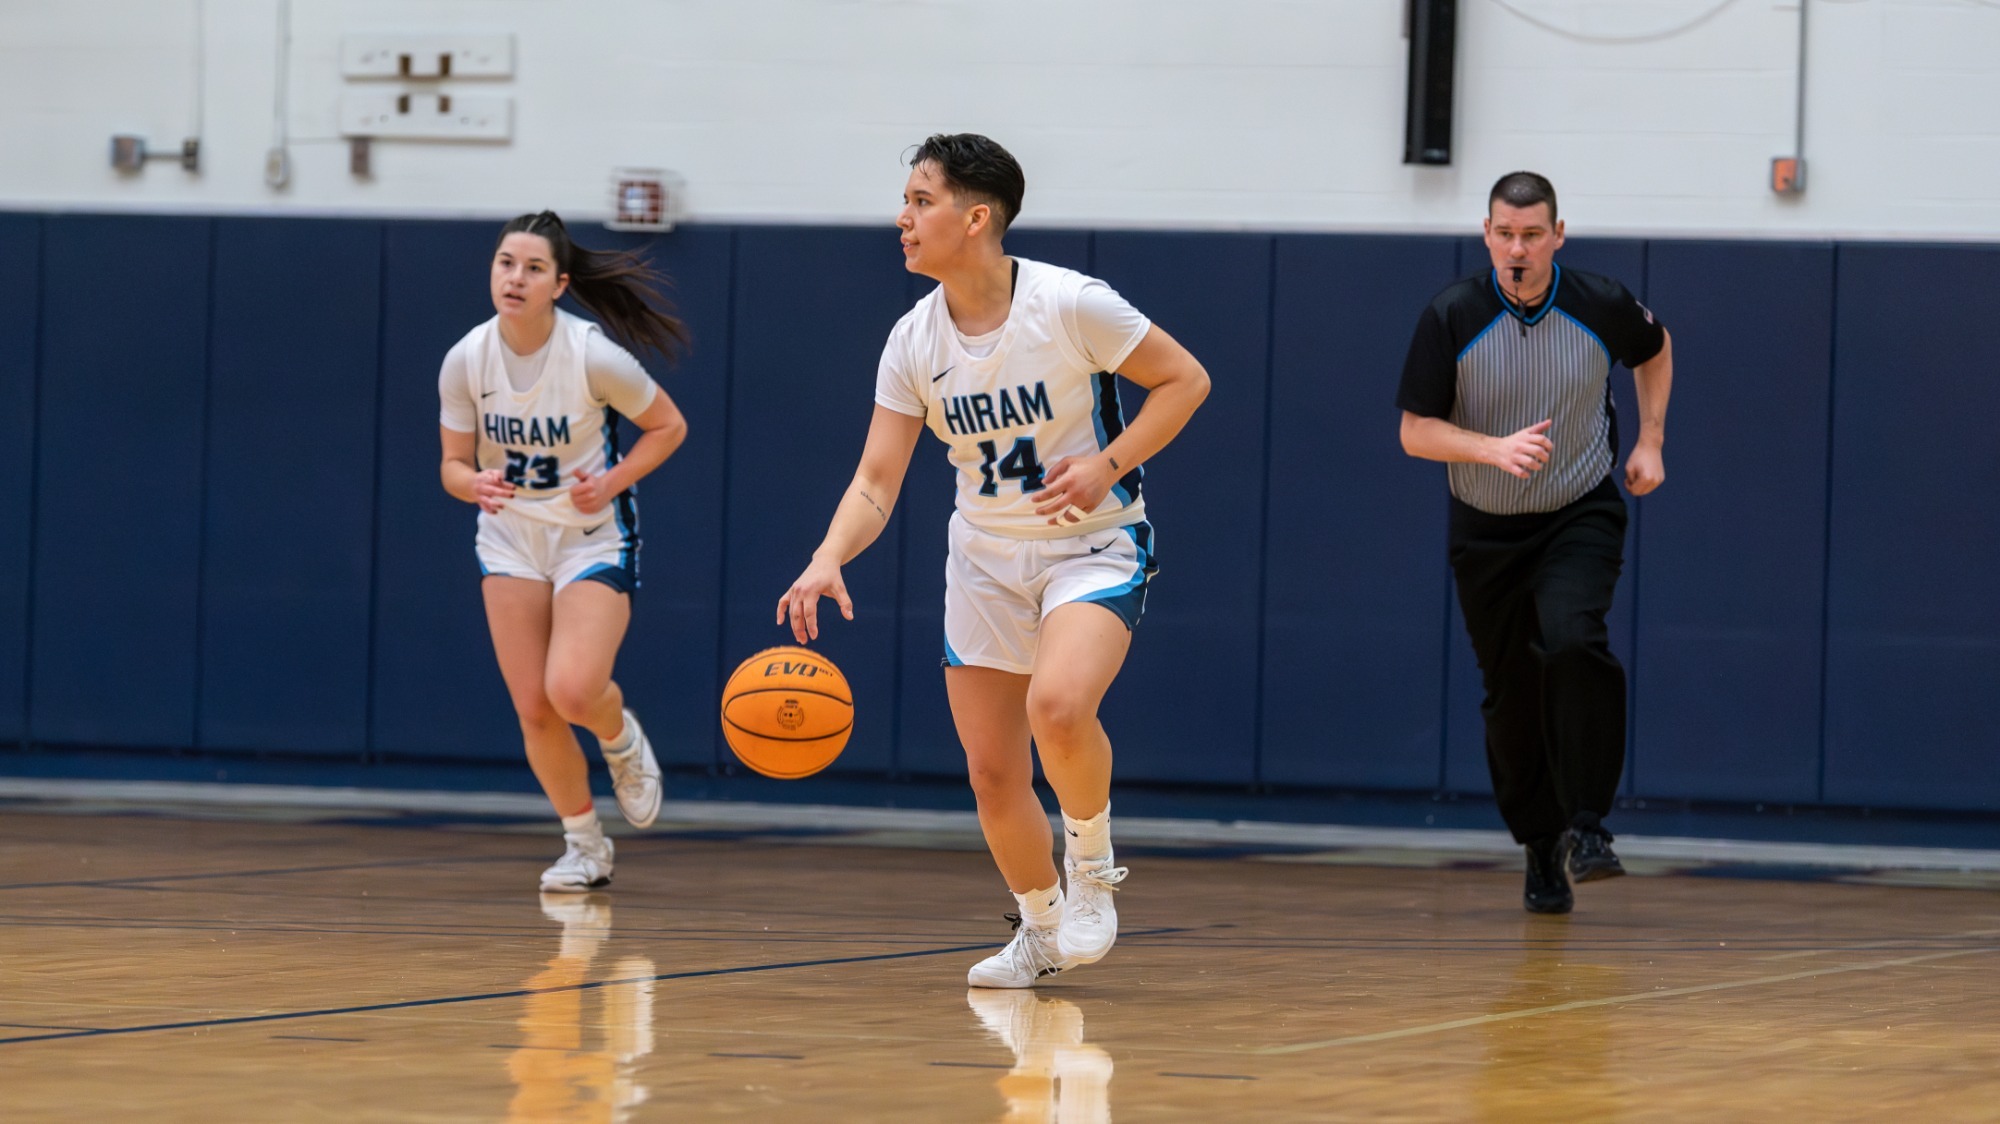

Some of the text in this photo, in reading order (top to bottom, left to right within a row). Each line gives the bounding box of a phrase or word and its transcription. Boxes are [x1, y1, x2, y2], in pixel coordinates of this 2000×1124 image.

[942, 380, 1055, 435] HIRAM
[484, 413, 571, 447] HIRAM
[504, 449, 560, 490] 23
[977, 436, 1046, 497] 14
[764, 661, 818, 677] EVO
